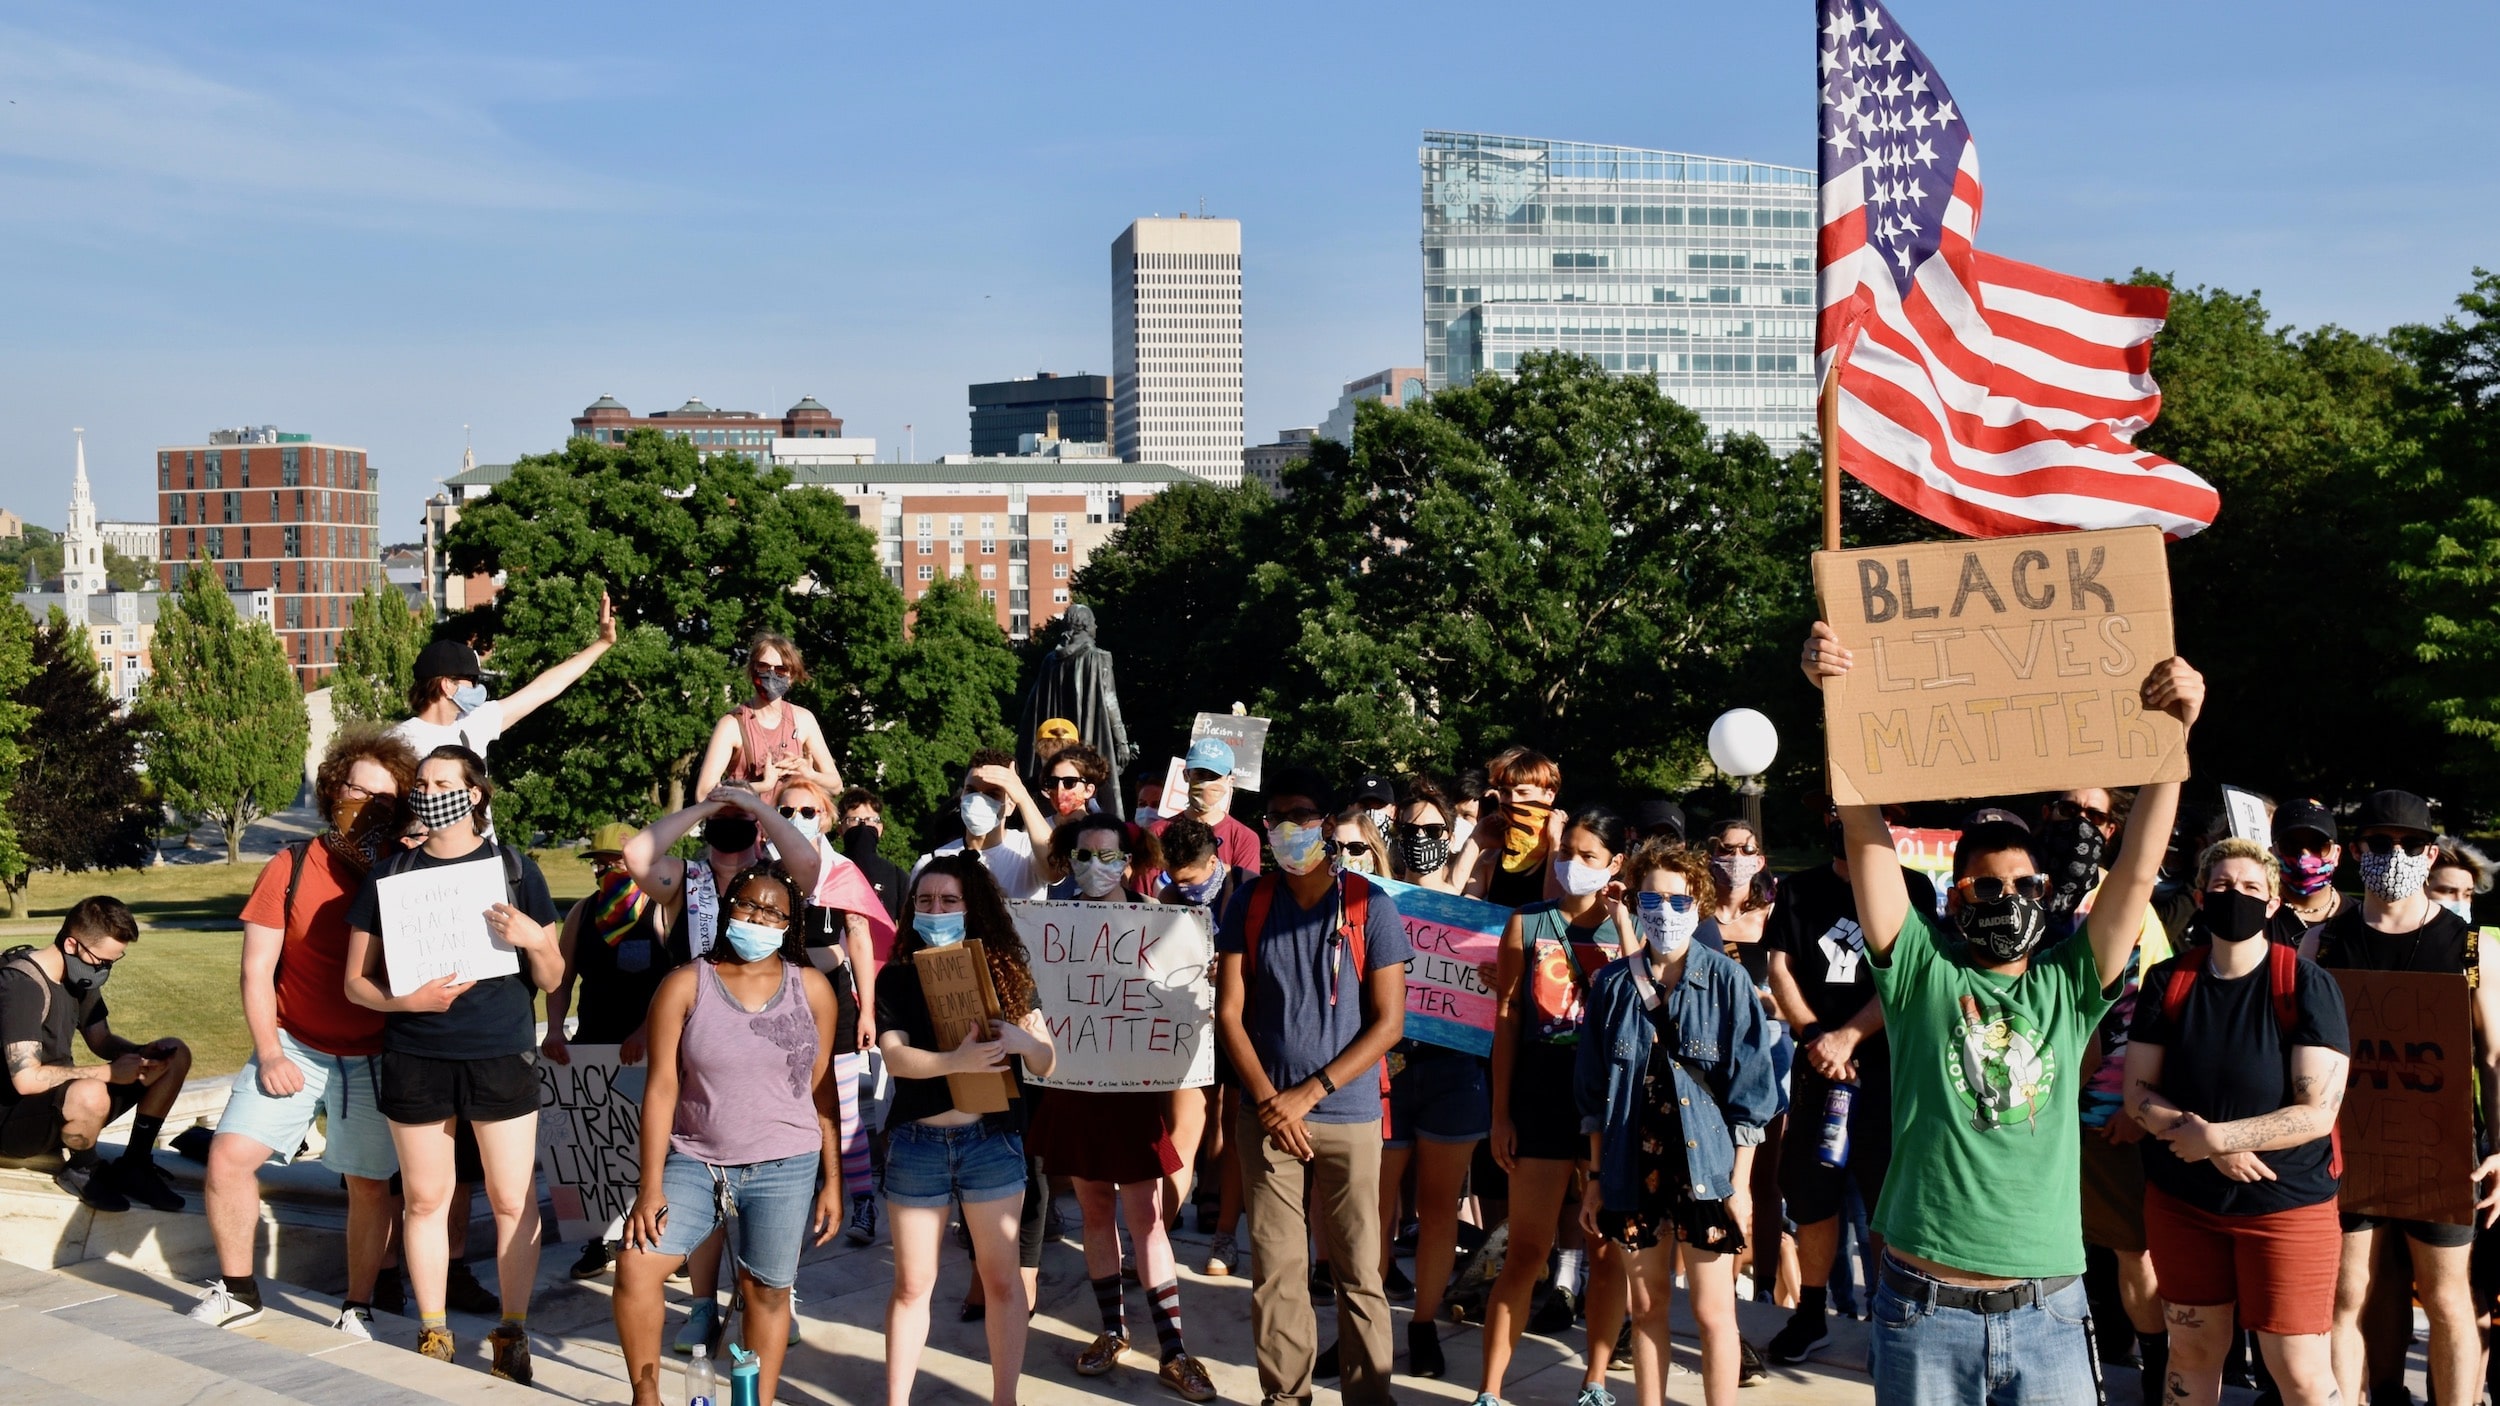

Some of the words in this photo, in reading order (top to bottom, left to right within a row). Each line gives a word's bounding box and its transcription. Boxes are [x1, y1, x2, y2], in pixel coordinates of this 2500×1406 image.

[1857, 546, 2115, 623] BLACK
[1871, 615, 2136, 692] LIVES
[1203, 718, 1233, 737] Racism
[1859, 689, 2158, 774] MATTER
[400, 907, 462, 937] BLACK
[1044, 922, 1161, 971] BLACK
[1067, 974, 1163, 1012] LIVES
[1045, 1015, 1194, 1059] MATTER
[538, 1065, 635, 1108] BLACK
[551, 1145, 641, 1185] LIVES
